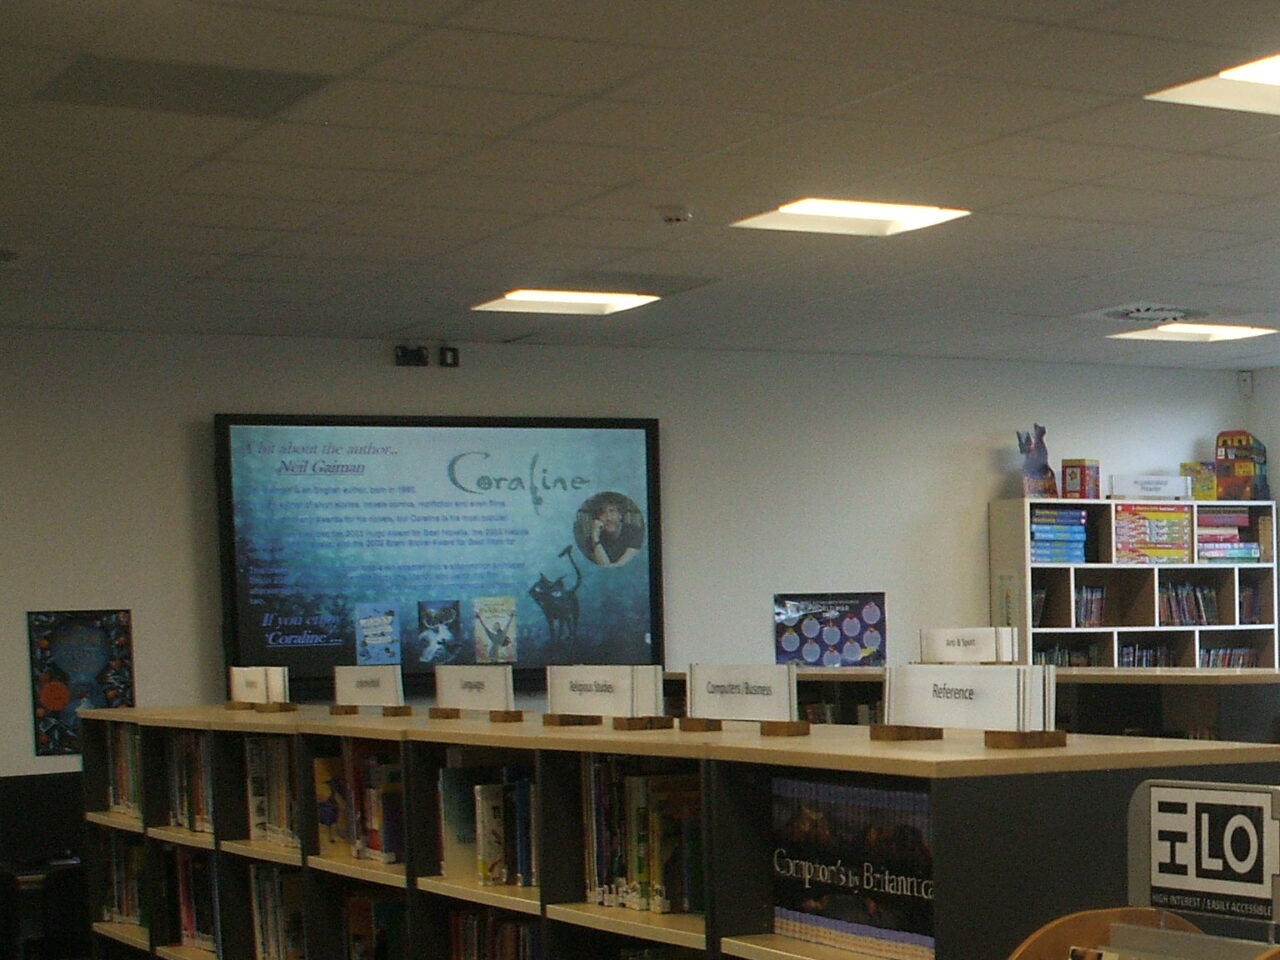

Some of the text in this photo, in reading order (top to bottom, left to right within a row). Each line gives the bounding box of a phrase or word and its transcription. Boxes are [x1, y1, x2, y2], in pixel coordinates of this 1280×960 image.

[278, 459, 365, 473] Neil Gaiman
[448, 451, 591, 516] Coraline
[932, 683, 975, 700] Reference
